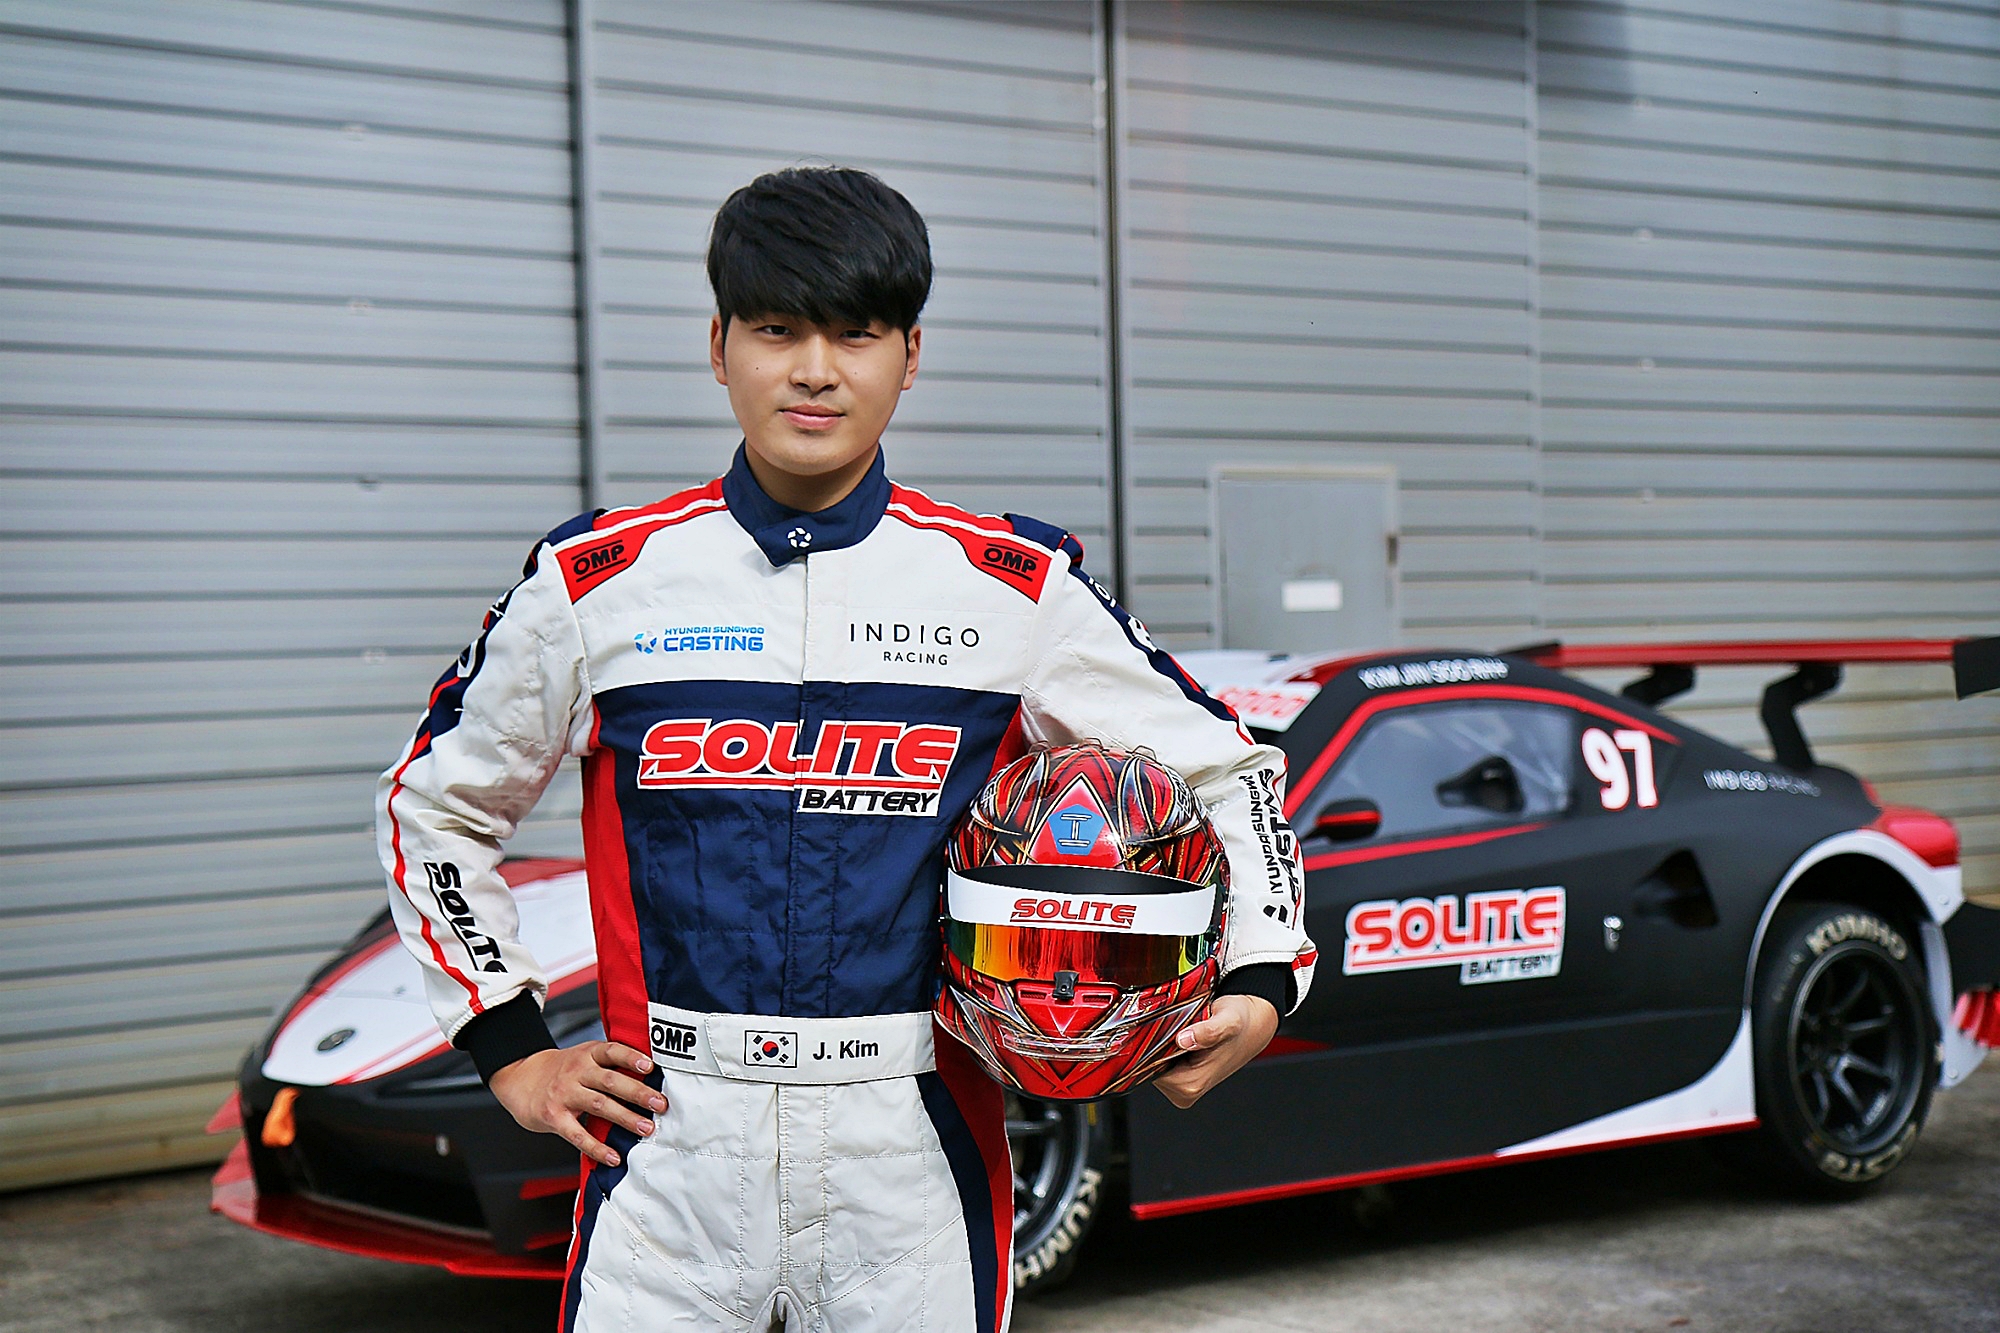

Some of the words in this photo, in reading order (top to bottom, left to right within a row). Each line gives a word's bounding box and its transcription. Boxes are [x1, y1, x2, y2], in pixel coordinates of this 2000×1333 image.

[573, 544, 625, 575] OMP
[983, 547, 1037, 574] OMP
[663, 635, 764, 652] CASTING
[665, 626, 711, 636] HYUNDAI
[713, 625, 765, 635] SUNGWOO
[850, 623, 980, 648] INDIGO
[883, 651, 949, 666] RACING
[638, 719, 962, 786] SOLITE
[1581, 726, 1658, 811] 97
[802, 788, 938, 813] BATTERY
[1010, 898, 1137, 926] SOLITE
[1347, 890, 1563, 960] SOLITE
[651, 1024, 697, 1053] OMP
[813, 1041, 832, 1060] J.
[839, 1040, 879, 1059] Kim
